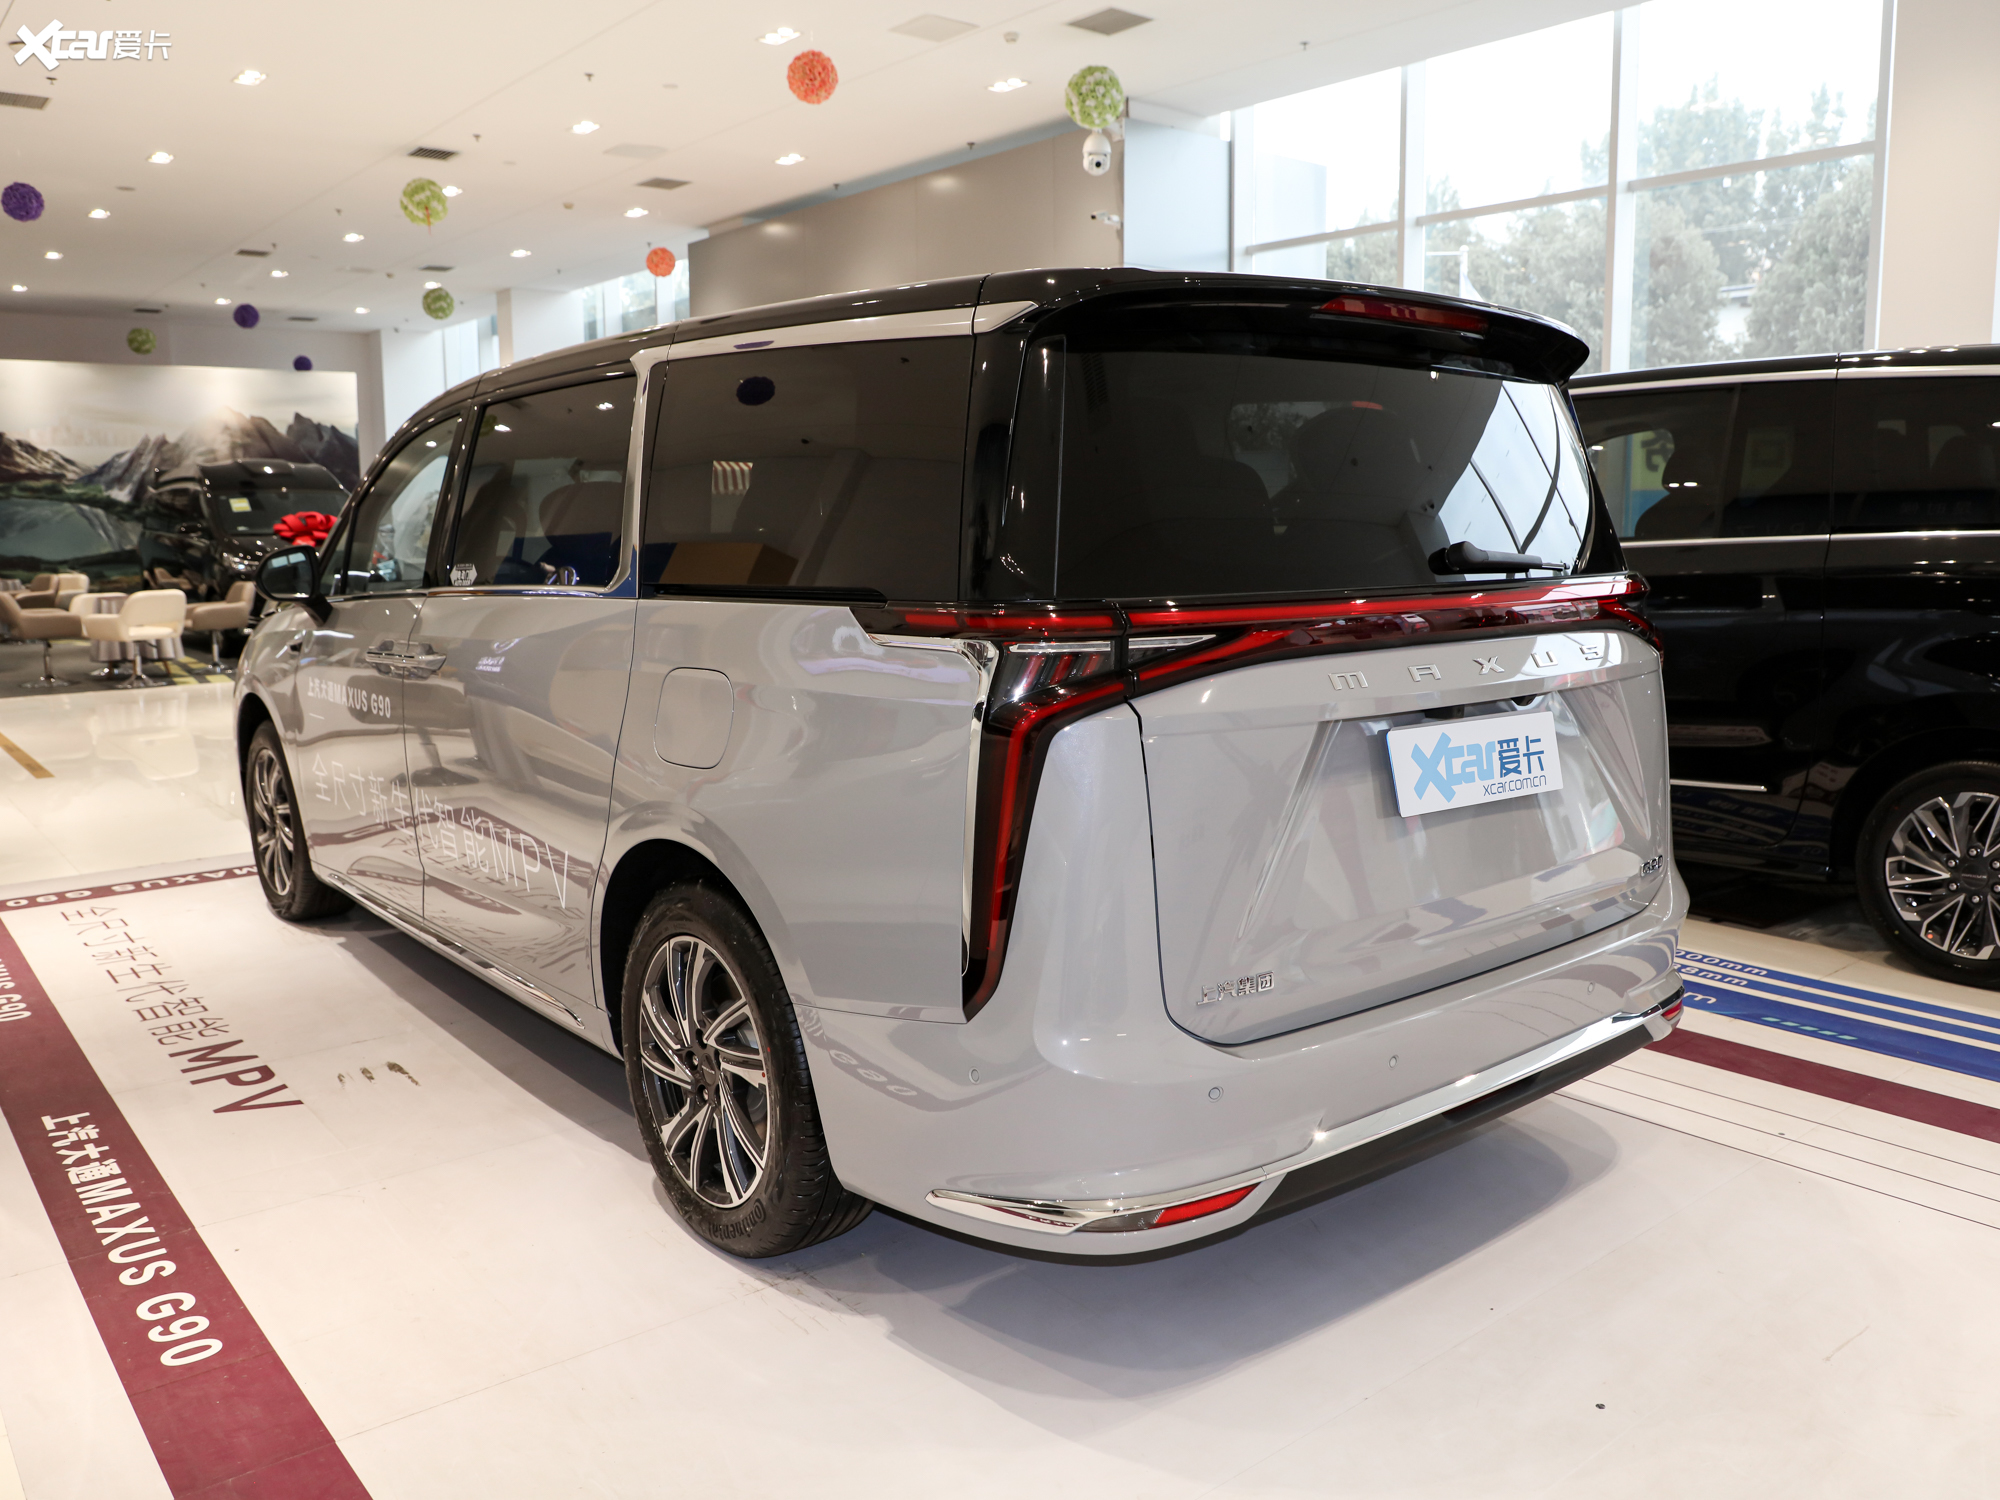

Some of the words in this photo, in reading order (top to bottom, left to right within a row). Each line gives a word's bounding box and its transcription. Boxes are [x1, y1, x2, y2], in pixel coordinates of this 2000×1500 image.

[1328, 645, 1603, 690] MAXUS
[371, 693, 391, 719] G90
[708, 1197, 767, 1241] Continental
[136, 1292, 223, 1367] G90
